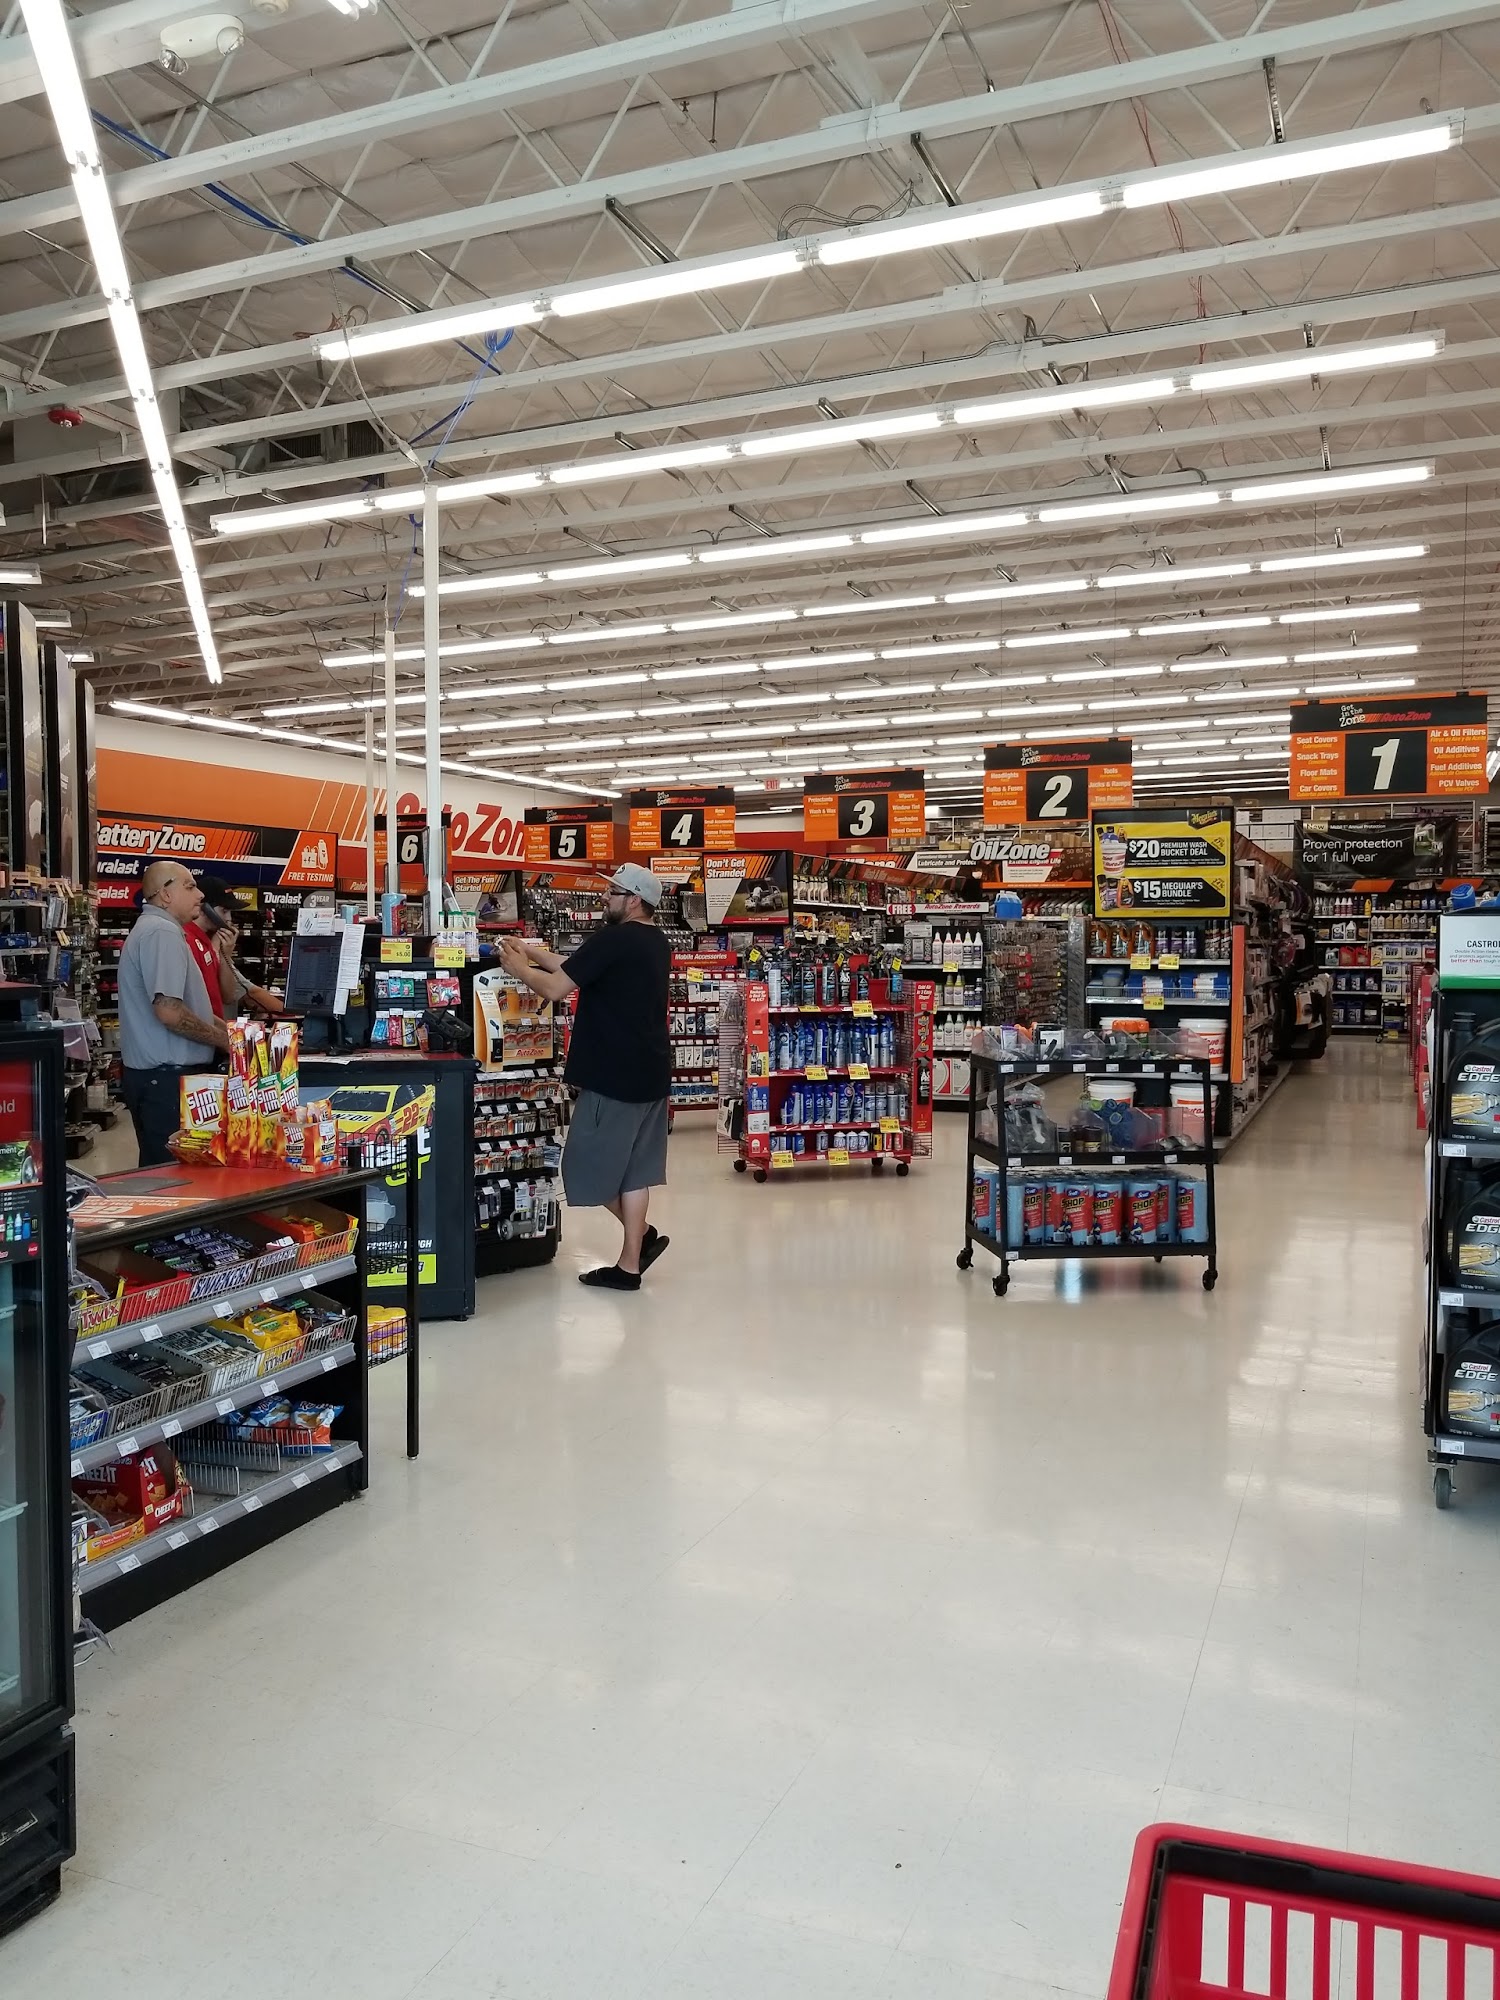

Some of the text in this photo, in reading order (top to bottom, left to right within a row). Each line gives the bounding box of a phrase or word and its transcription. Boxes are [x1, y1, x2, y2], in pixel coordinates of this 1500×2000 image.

[1339, 713, 1366, 727] Zone
[1381, 711, 1432, 723] AutoZone
[1430, 730, 1442, 738] Air
[1451, 729, 1461, 737] Oil
[1462, 728, 1486, 736] Filters
[1296, 736, 1338, 744] Seat Covers
[1446, 746, 1480, 754] Additives
[1020, 756, 1040, 766] Zone
[1296, 752, 1339, 760] Snack Trays
[1372, 738, 1400, 790] 1
[1448, 762, 1482, 770] Additives
[990, 772, 1019, 780] Headlights
[1320, 768, 1338, 776] Mats
[766, 780, 778, 790] EXIT
[1314, 784, 1338, 792] Covers
[1038, 775, 1073, 818] 2
[850, 800, 876, 836] 3
[670, 814, 693, 846] 4
[97, 820, 206, 854] atteryZone
[401, 834, 418, 862] 6
[558, 829, 577, 858] 5
[1302, 838, 1403, 851] Proven protection
[970, 841, 1050, 861] OilZone
[1129, 840, 1160, 858] $20
[1160, 848, 1208, 856] BUCKET DEAL
[706, 858, 746, 868] Don't Get
[1302, 852, 1376, 865] for 1 full year
[288, 872, 334, 883] FREE TESTING
[706, 869, 746, 878] Stranded
[454, 876, 496, 884] Get The Fun
[574, 877, 594, 890] Towing
[455, 884, 482, 892] Started
[1134, 880, 1161, 898] $15
[1162, 881, 1204, 890] MEGUIAR'S
[264, 892, 302, 904] Duralast
[1162, 889, 1192, 898] BUNDLE
[892, 904, 912, 914] FREE
[574, 912, 589, 920] FREE
[1458, 1072, 1500, 1082] EDGE
[0, 1100, 16, 1113] old
[402, 1102, 420, 1133] 22
[1096, 1190, 1108, 1198] Scott
[1132, 1198, 1154, 1210] SHOP
[404, 1240, 432, 1250] TGH
[1454, 1369, 1498, 1382] EDGE
